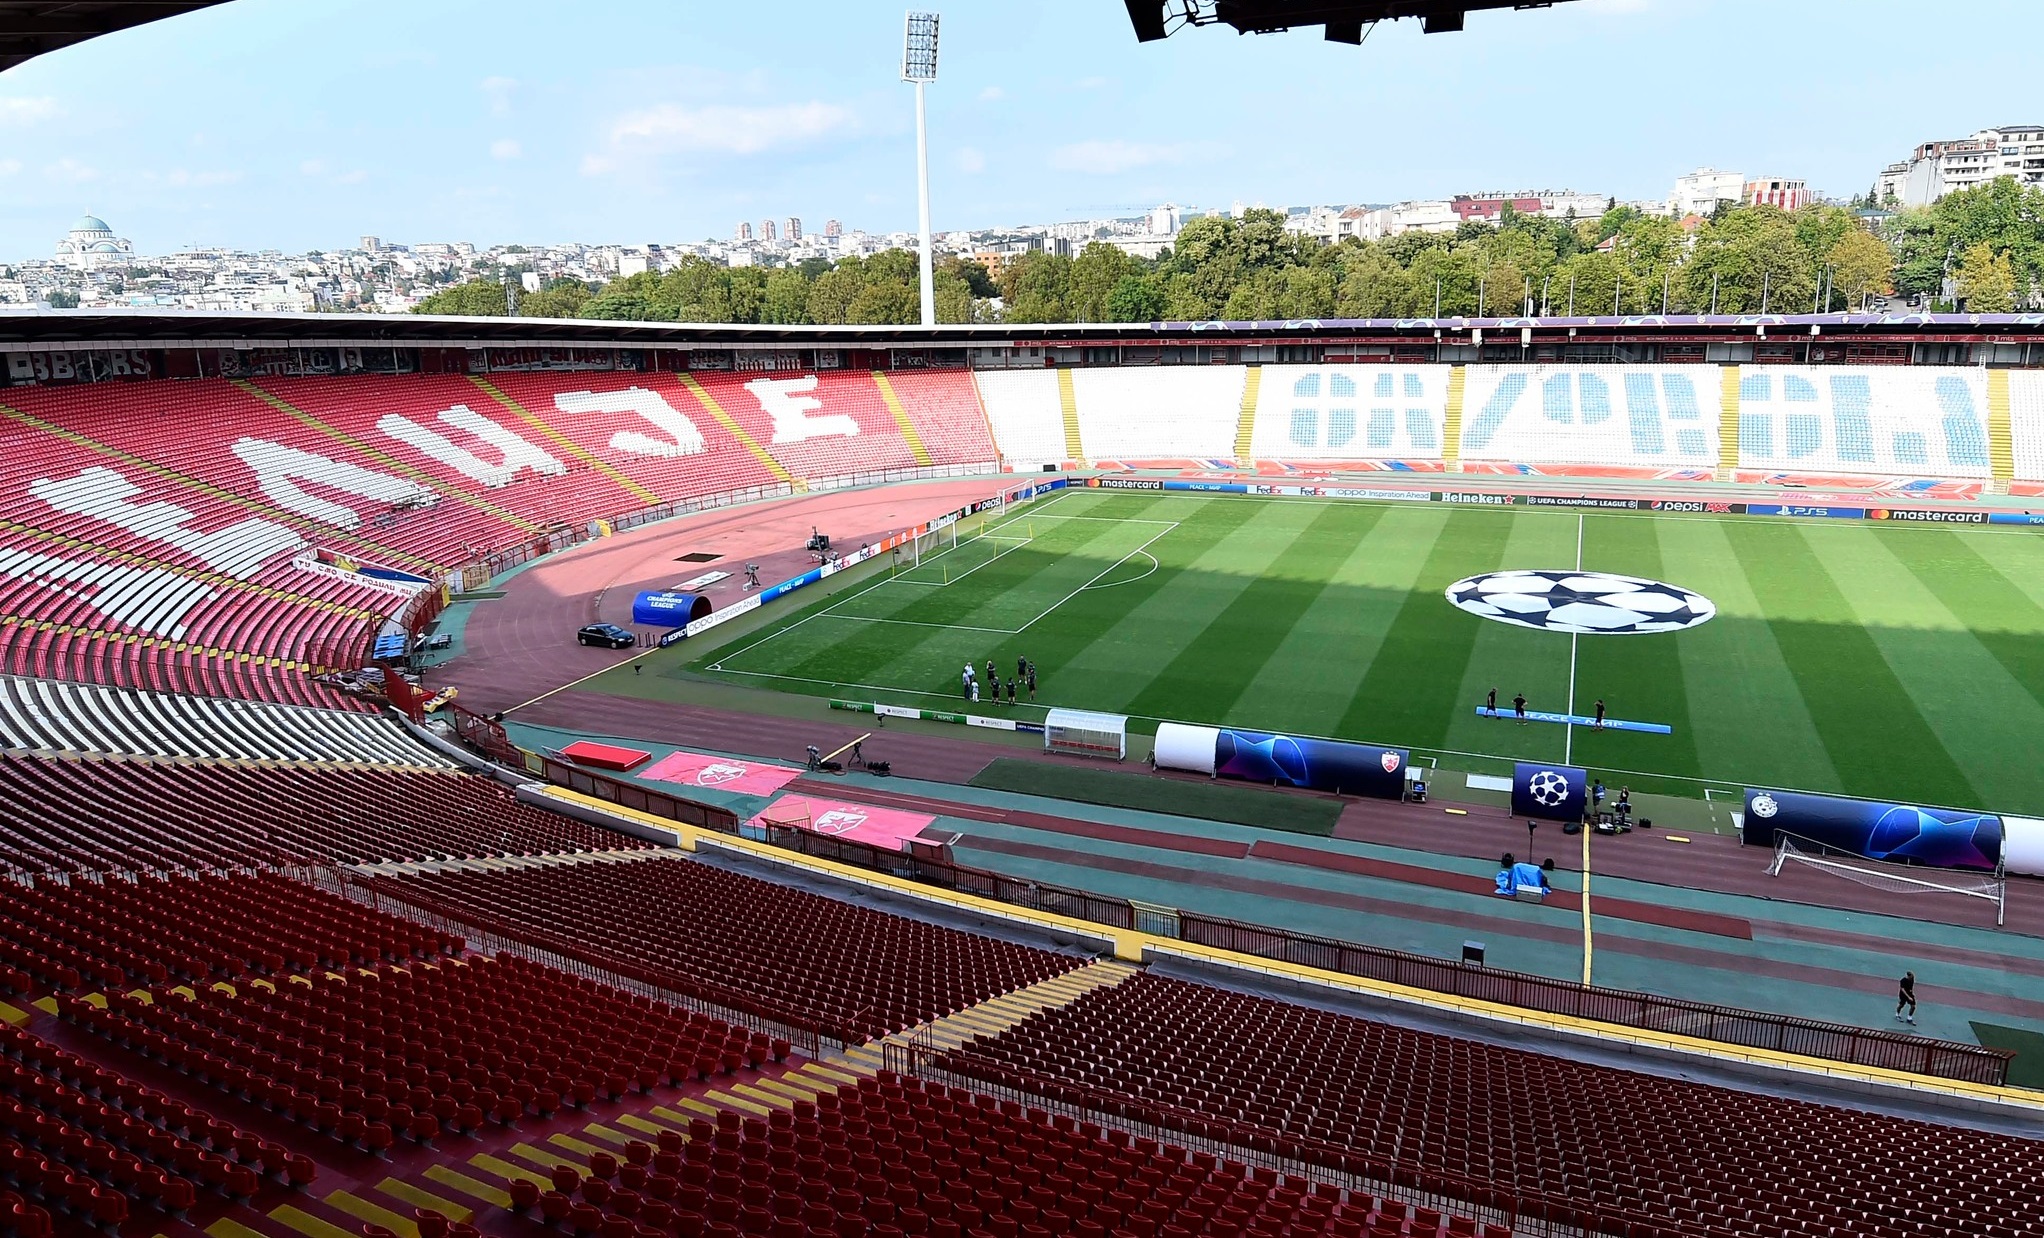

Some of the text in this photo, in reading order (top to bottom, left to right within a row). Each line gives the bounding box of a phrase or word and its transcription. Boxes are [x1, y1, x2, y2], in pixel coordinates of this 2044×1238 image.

[1102, 478, 1160, 490] mastercard
[1256, 486, 1282, 494] FedEx
[1300, 487, 1326, 496] FedEx
[1338, 488, 1366, 496] oppo
[1368, 490, 1404, 498] Inspiration
[1442, 492, 1502, 504] Heineken
[1664, 502, 1732, 512] pepsi MAX
[1794, 508, 1828, 516] PS5
[1893, 510, 1982, 522] mastercard
[860, 548, 876, 560] FedEx
[833, 558, 851, 572] FedEx
[647, 596, 683, 604] CHAMPIONS
[688, 596, 760, 632] oppo Inspiration Ahead
[668, 628, 687, 642] RESPECT
